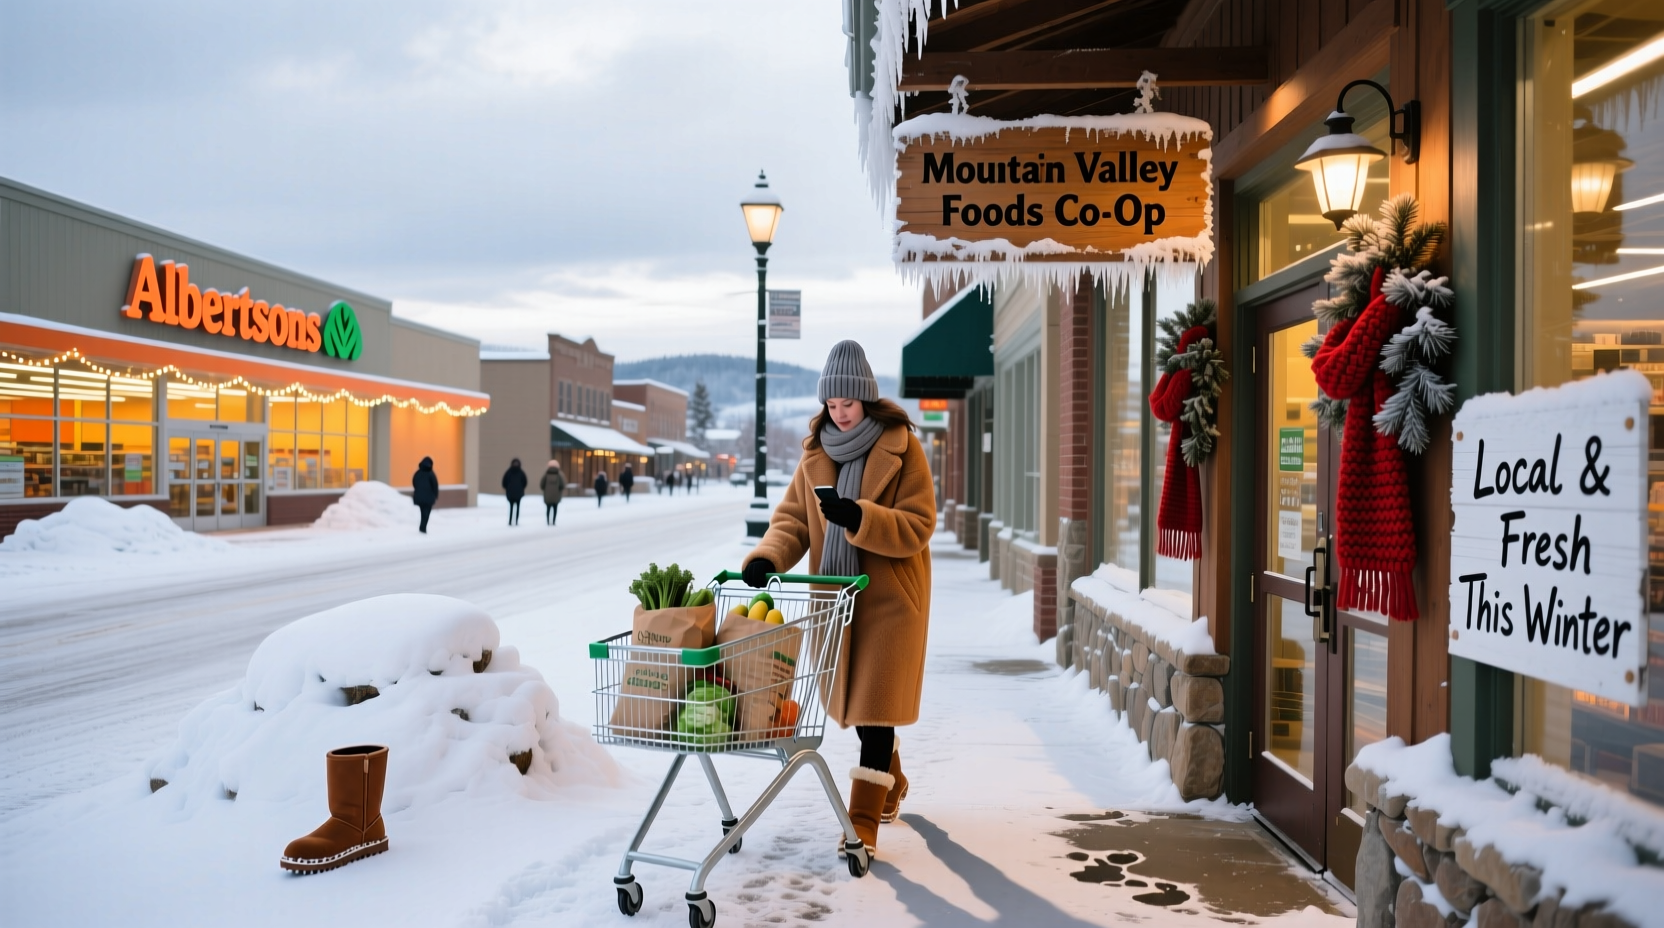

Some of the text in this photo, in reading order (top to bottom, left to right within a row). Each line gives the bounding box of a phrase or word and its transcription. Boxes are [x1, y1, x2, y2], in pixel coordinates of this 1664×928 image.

[1074, 151, 1178, 191] Valley
[943, 194, 1165, 234] Foods Co-Op
[122, 253, 322, 352] Albertsons
[1474, 433, 1610, 499] Local &
[1501, 511, 1590, 575] Fresh
[1459, 573, 1631, 658] This Winter
